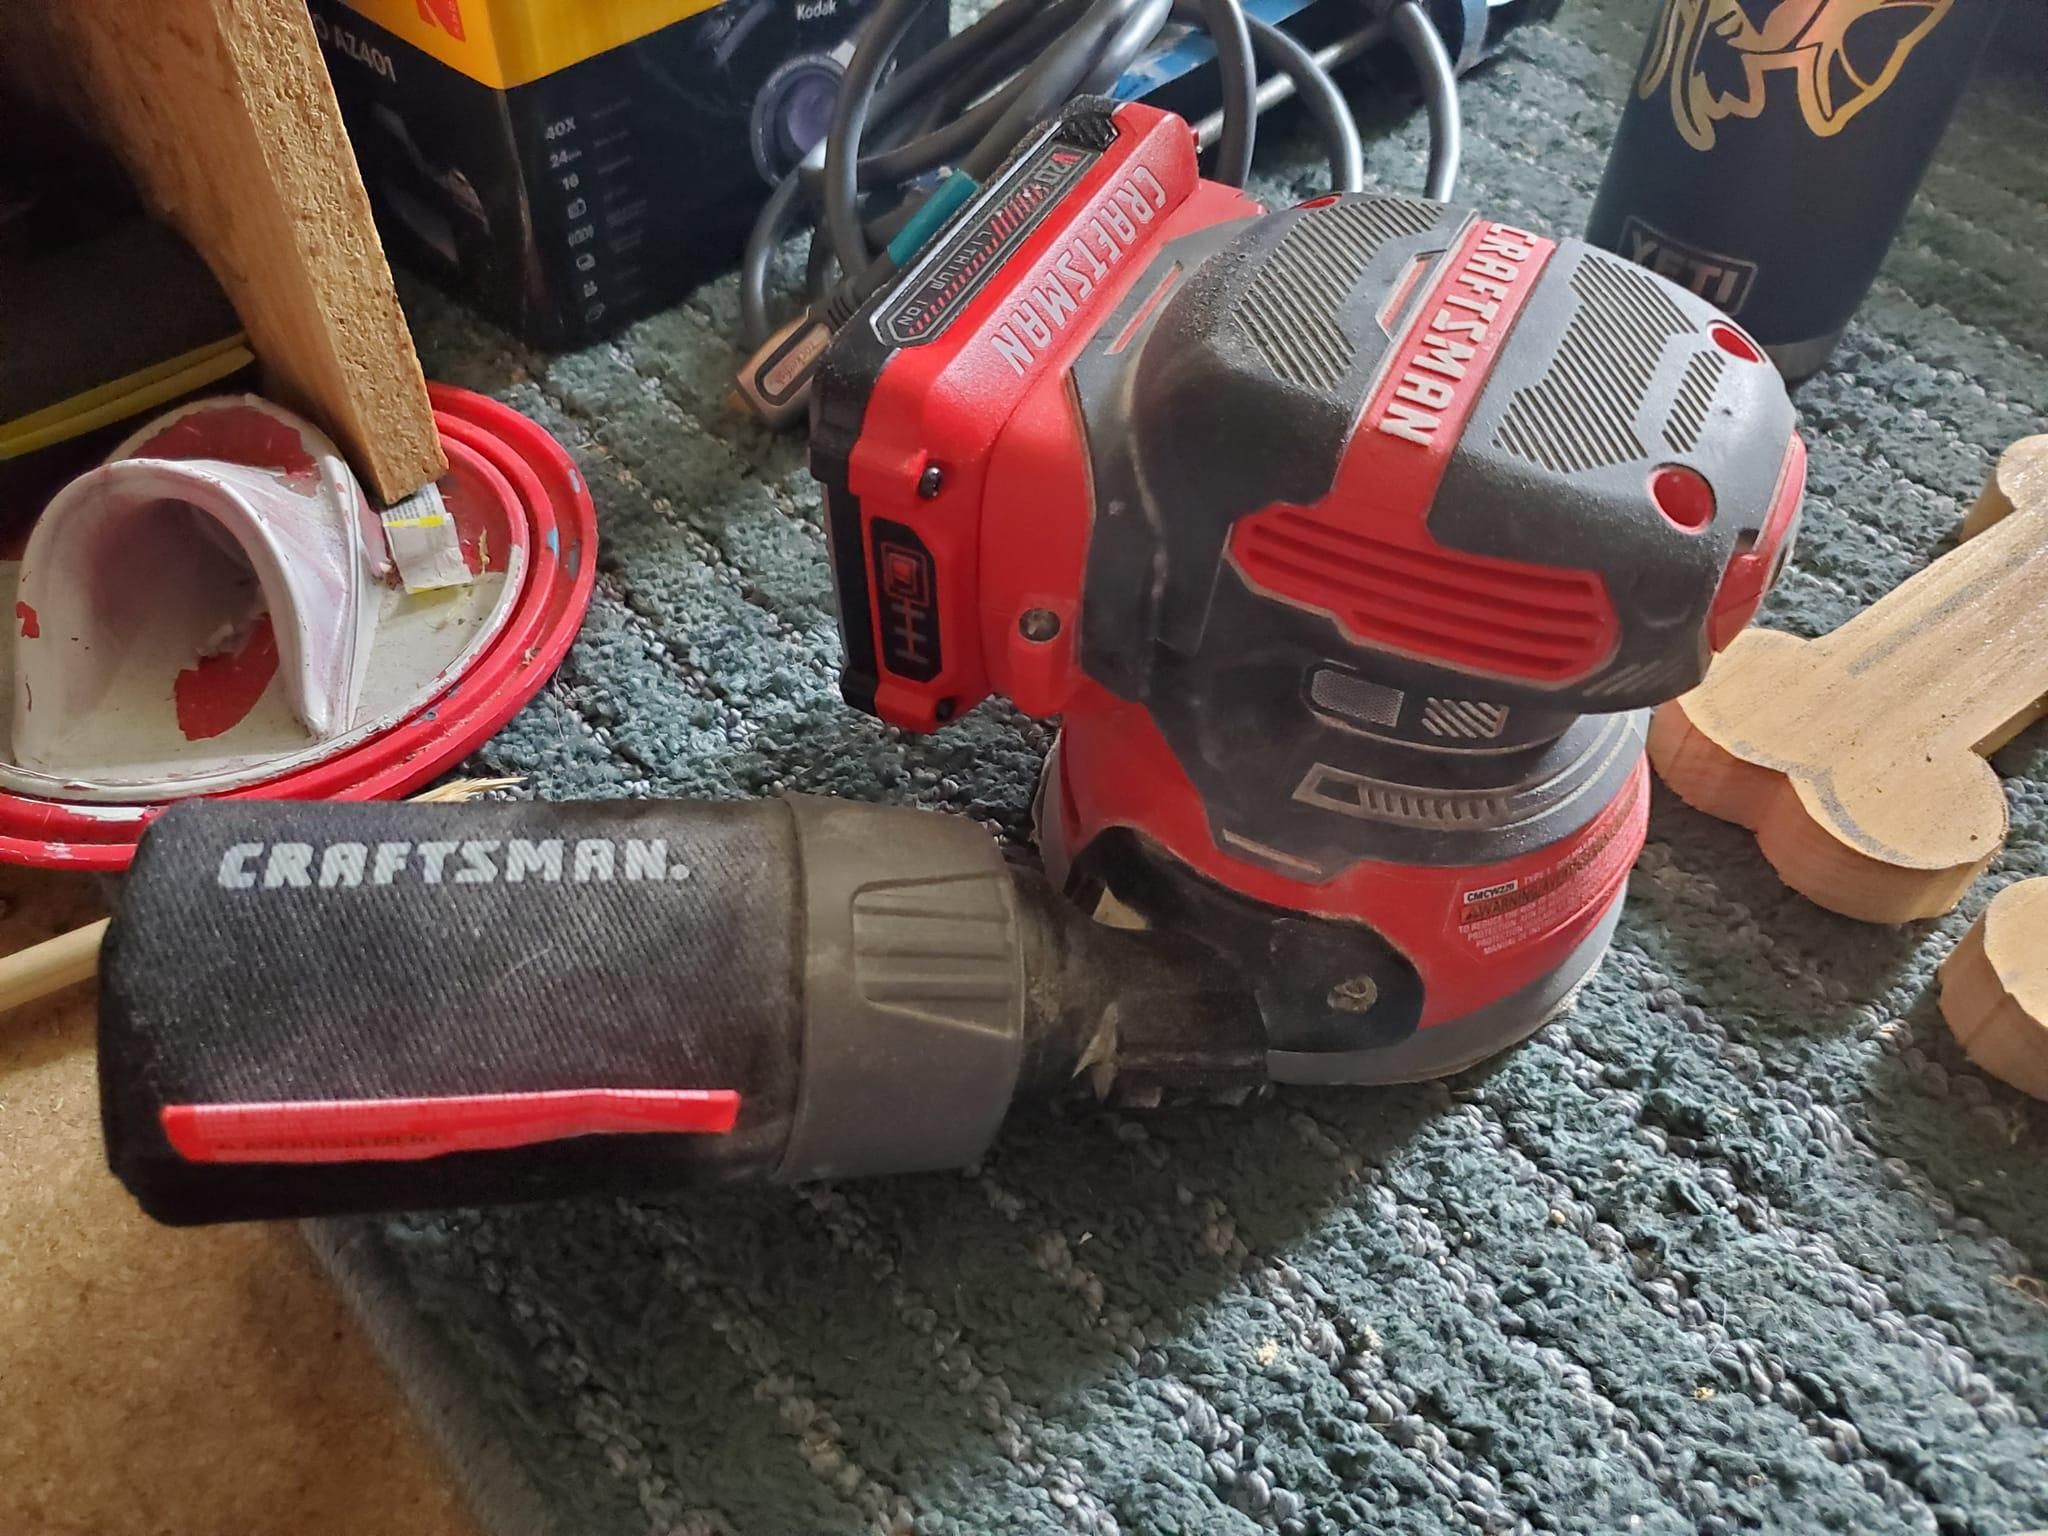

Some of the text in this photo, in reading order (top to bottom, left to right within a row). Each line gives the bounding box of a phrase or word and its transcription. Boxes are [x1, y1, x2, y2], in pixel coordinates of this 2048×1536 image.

[797, 0, 838, 21] Kodak
[333, 25, 397, 83] AZ401
[545, 116, 576, 140] 40X
[1033, 152, 1081, 186] V20
[897, 229, 993, 327] LITHIUM ION
[989, 163, 1167, 377] CRAFTSMAN
[1632, 231, 1739, 303] YETI
[1378, 222, 1539, 447] CRAFTSMAN
